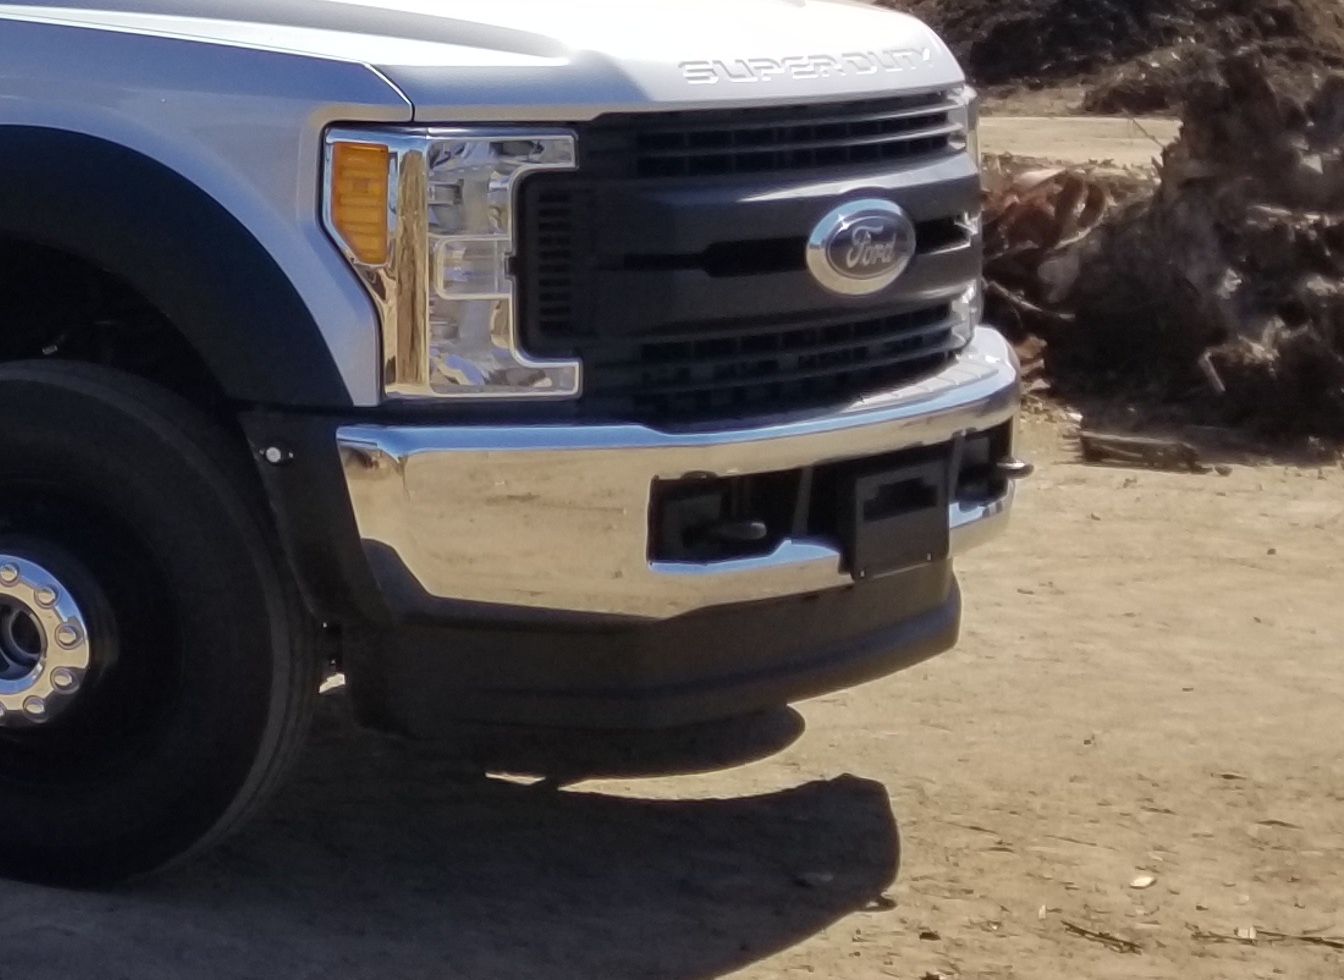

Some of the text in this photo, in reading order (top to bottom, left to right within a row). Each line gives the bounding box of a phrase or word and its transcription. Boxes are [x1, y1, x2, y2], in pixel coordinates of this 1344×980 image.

[678, 48, 932, 84] SUPER DUTY
[845, 225, 897, 269] Ford
